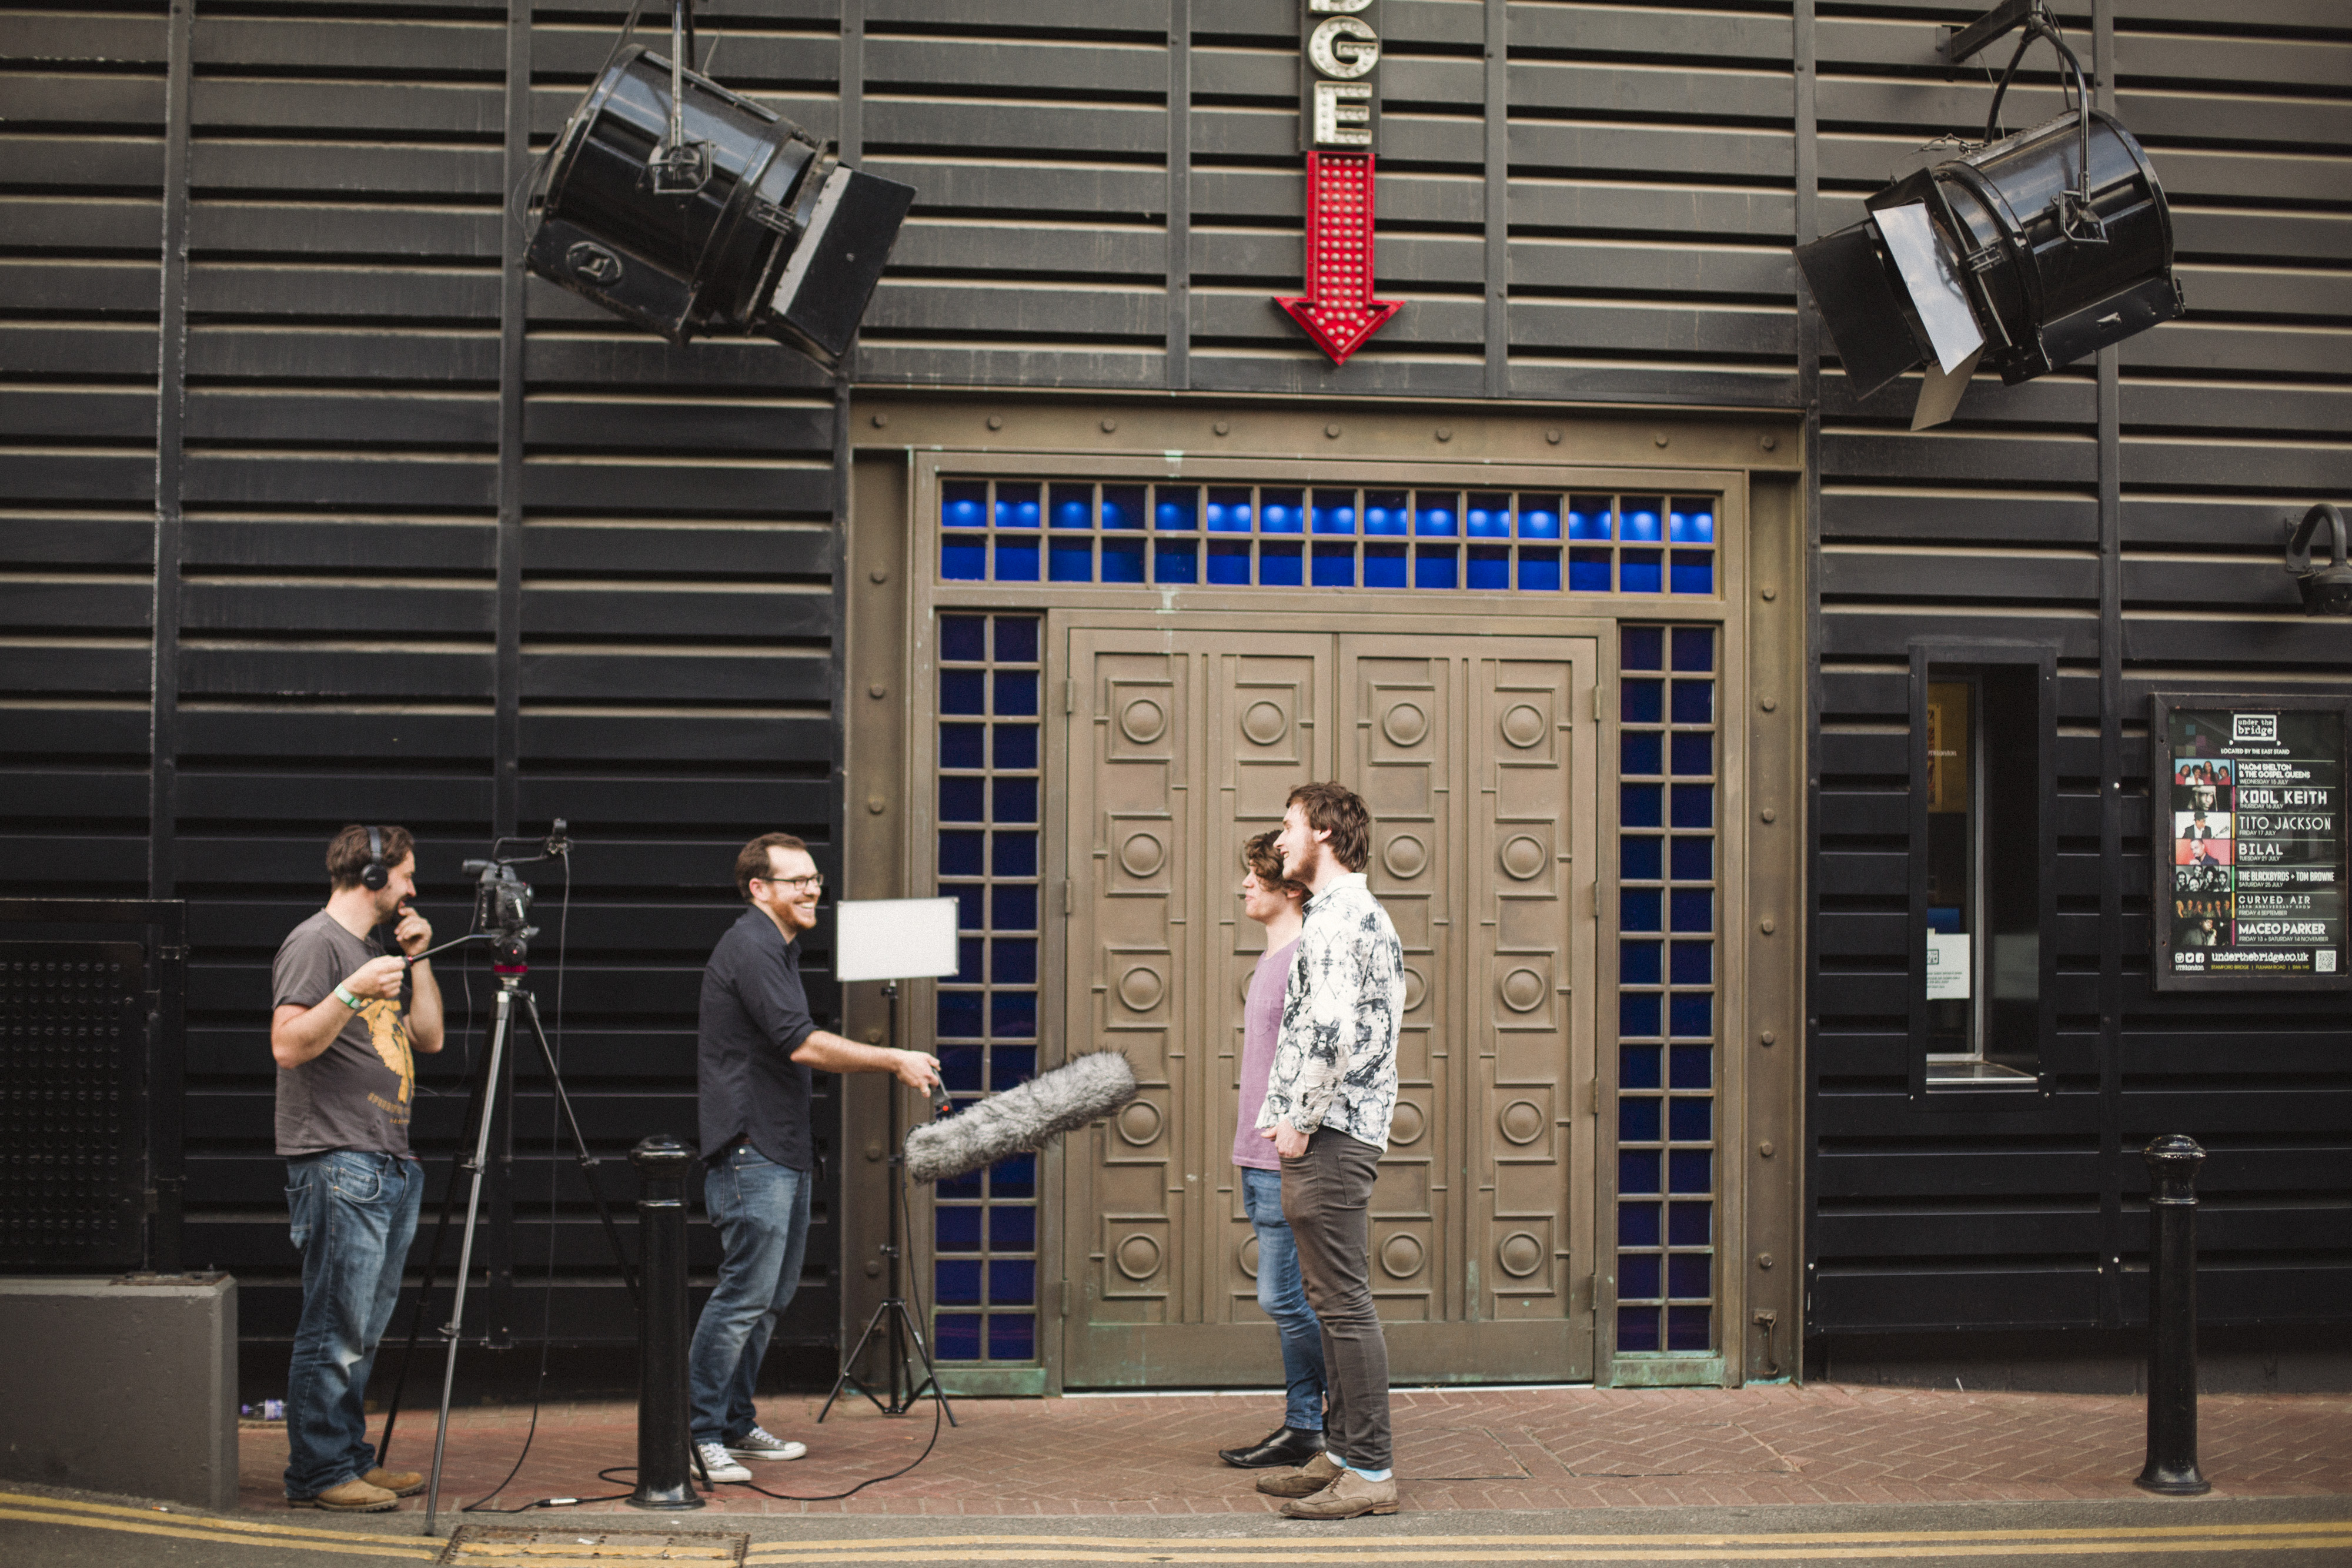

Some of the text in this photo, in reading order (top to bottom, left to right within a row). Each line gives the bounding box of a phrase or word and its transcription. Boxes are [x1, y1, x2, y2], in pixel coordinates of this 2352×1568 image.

[1308, 0, 1379, 145] GE
[2238, 725, 2273, 736] bridge
[2240, 790, 2327, 804] KOOL KEITH
[2239, 816, 2331, 830] TITO JACKSON
[2239, 843, 2284, 855] BILAL
[2239, 871, 2250, 881] THE
[2251, 871, 2290, 881] BLACKBYRDS
[2296, 871, 2308, 882] TOM
[2310, 871, 2334, 882] BROWNE
[2238, 895, 2311, 904] CURVED AIR
[2239, 923, 2326, 935] MACEO PARKER
[2211, 952, 2309, 962] underthebridge.co.uk
